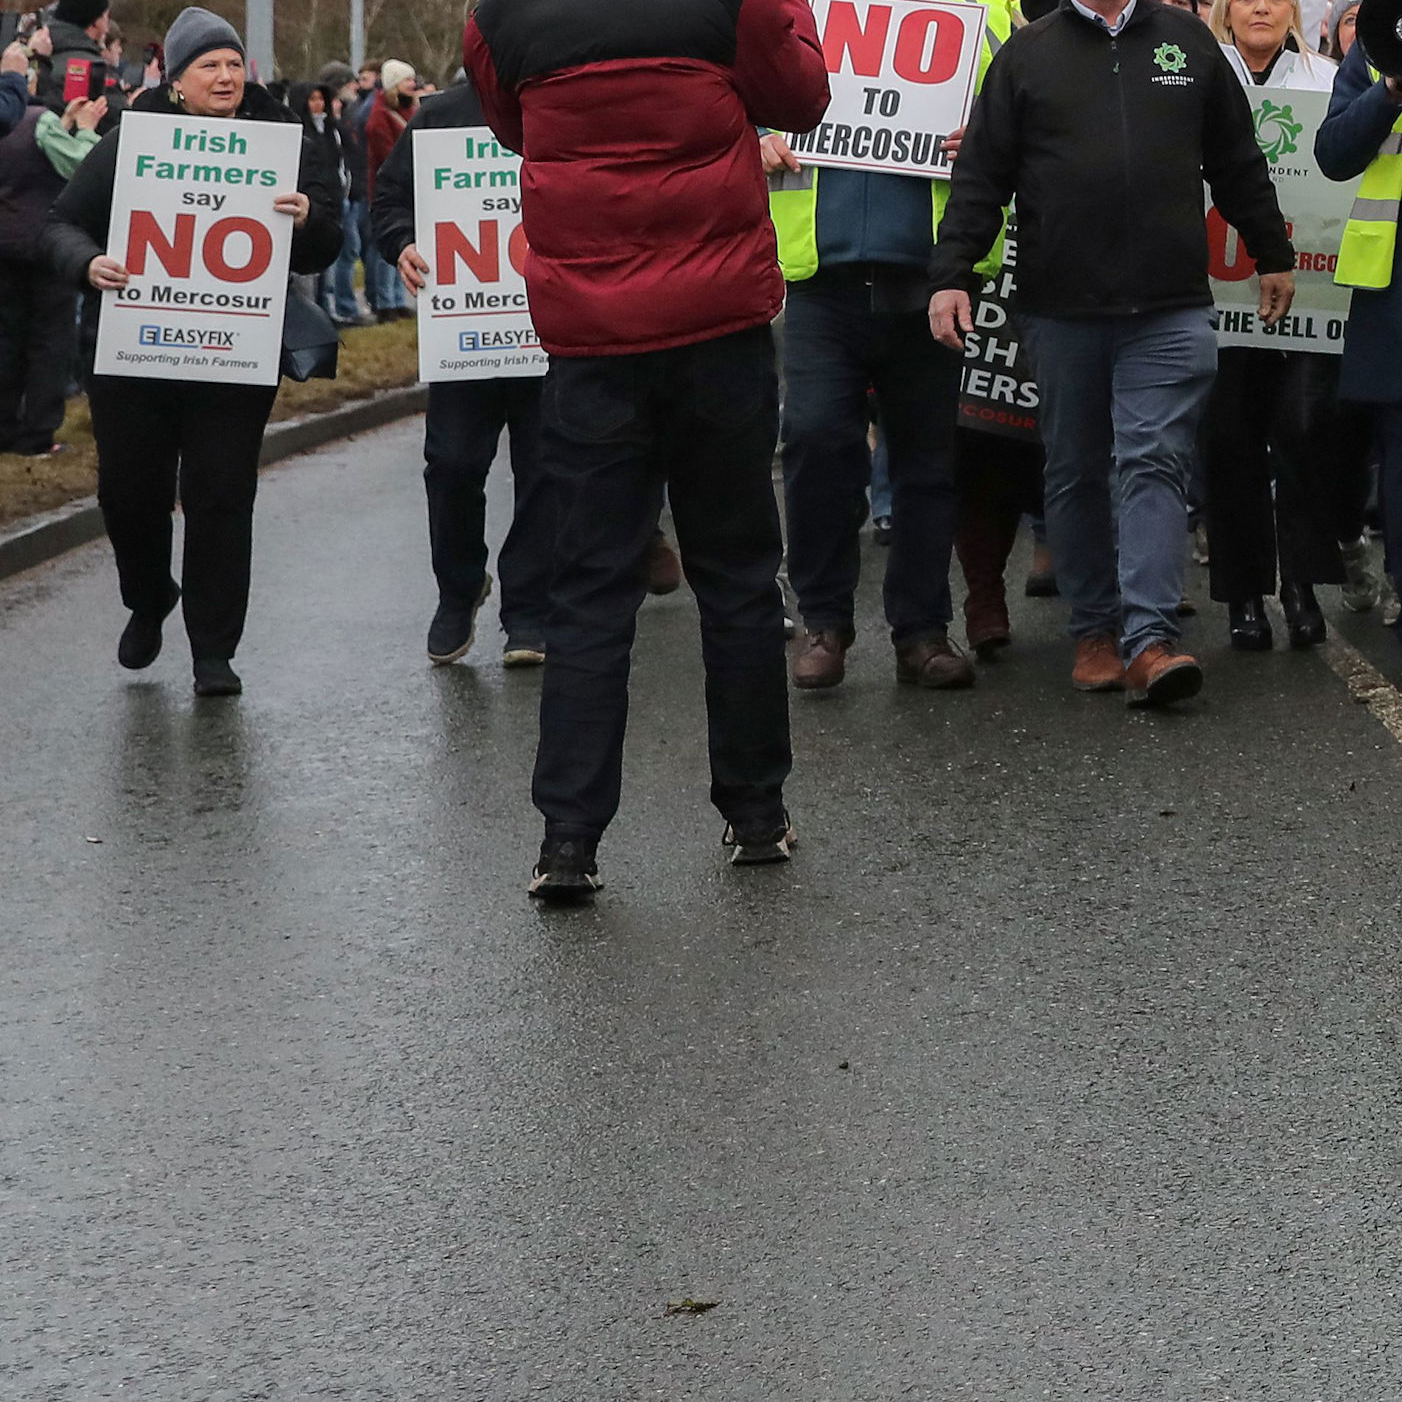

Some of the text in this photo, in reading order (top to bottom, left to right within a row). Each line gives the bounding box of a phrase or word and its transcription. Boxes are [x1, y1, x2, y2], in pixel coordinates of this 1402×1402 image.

[822, 0, 965, 85] NO
[863, 87, 901, 118] TO
[172, 128, 247, 155] Irish
[466, 137, 517, 159] Iris
[135, 155, 278, 187] Farmers
[182, 191, 227, 211] say
[482, 198, 522, 214] say
[125, 209, 273, 283] NO
[117, 286, 272, 309] to Mercosur
[431, 294, 455, 310] to
[163, 328, 234, 346] EASYFIX
[116, 351, 259, 369] Supporting Irish Farmers
[440, 358, 501, 370] Supporting
[504, 355, 529, 366] Irish
[960, 366, 1040, 409] ERS
[959, 404, 1037, 430] COSUR
